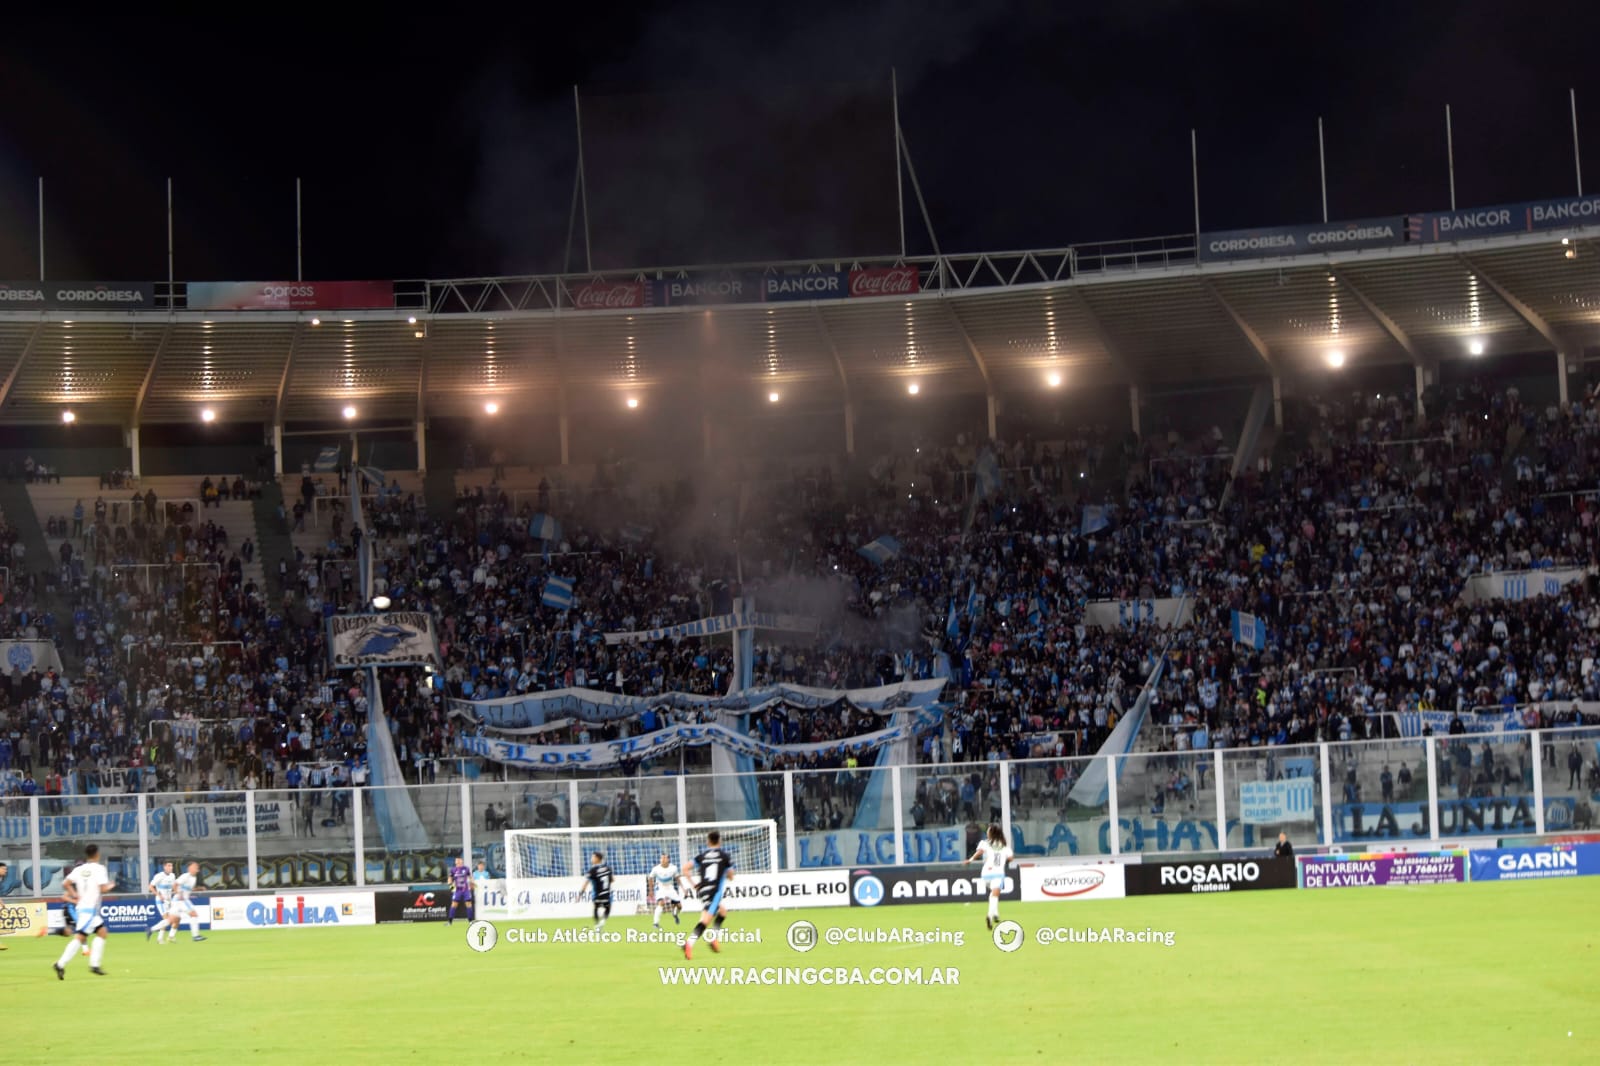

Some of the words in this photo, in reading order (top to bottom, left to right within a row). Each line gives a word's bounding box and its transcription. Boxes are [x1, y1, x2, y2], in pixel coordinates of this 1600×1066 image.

[1439, 209, 1511, 232] BANCOR
[1210, 234, 1296, 253] CORDOBESA
[1307, 225, 1394, 245] CORDOBESA
[671, 281, 743, 298] BANCOR
[767, 276, 839, 294] BANCOR
[0, 290, 45, 301] OBESA
[56, 290, 143, 301] CORDOBESA
[1351, 801, 1399, 837] LA
[1411, 796, 1536, 836] JUNTA
[1011, 822, 1078, 856] LA
[801, 835, 842, 867] LA
[1306, 861, 1376, 875] PINTURERIAS
[1498, 851, 1577, 871] GARIN
[1160, 862, 1259, 885] ROSARIO
[1307, 876, 1326, 887] DE
[1329, 875, 1345, 886] LA
[1346, 873, 1376, 886] VILLA
[778, 884, 811, 896] DEL
[817, 882, 847, 894] RIO
[1192, 882, 1230, 892] chateau
[541, 892, 566, 904] AGUA
[100, 905, 155, 917] CORMAC
